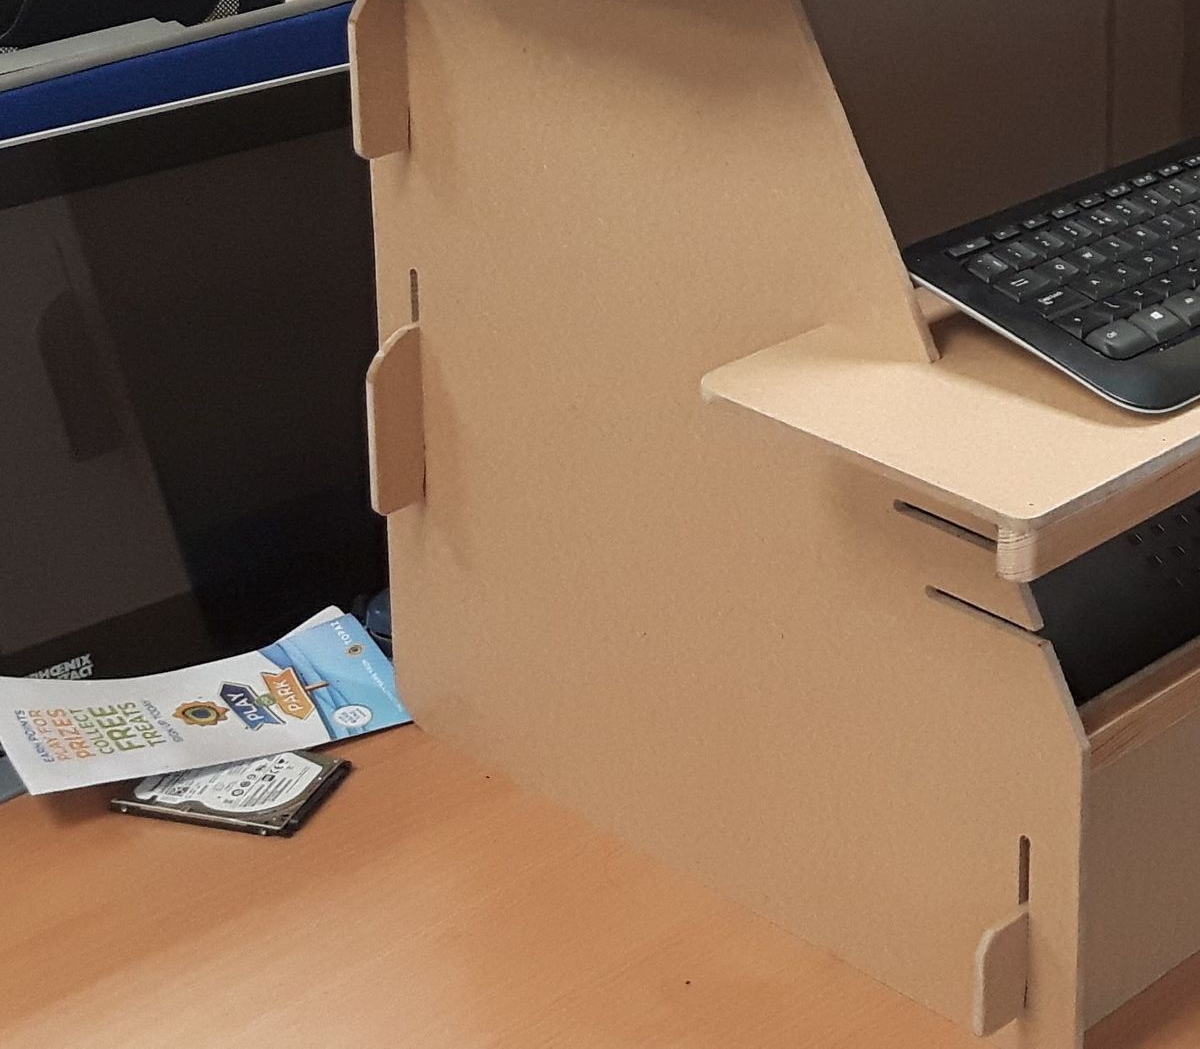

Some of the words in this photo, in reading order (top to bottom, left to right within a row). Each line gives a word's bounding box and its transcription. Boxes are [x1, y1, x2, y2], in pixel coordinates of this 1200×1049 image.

[331, 621, 352, 645] TOPAZ
[227, 693, 265, 721] PLAY
[273, 679, 304, 711] PARK
[14, 710, 41, 741] POINTS
[28, 710, 51, 734] FOR
[47, 709, 96, 759] PRIZES
[69, 709, 115, 754] COLLECT
[87, 704, 145, 751] FREE
[117, 701, 166, 747] TREATS
[36, 741, 55, 763] EARN
[44, 736, 71, 761] PLAY
